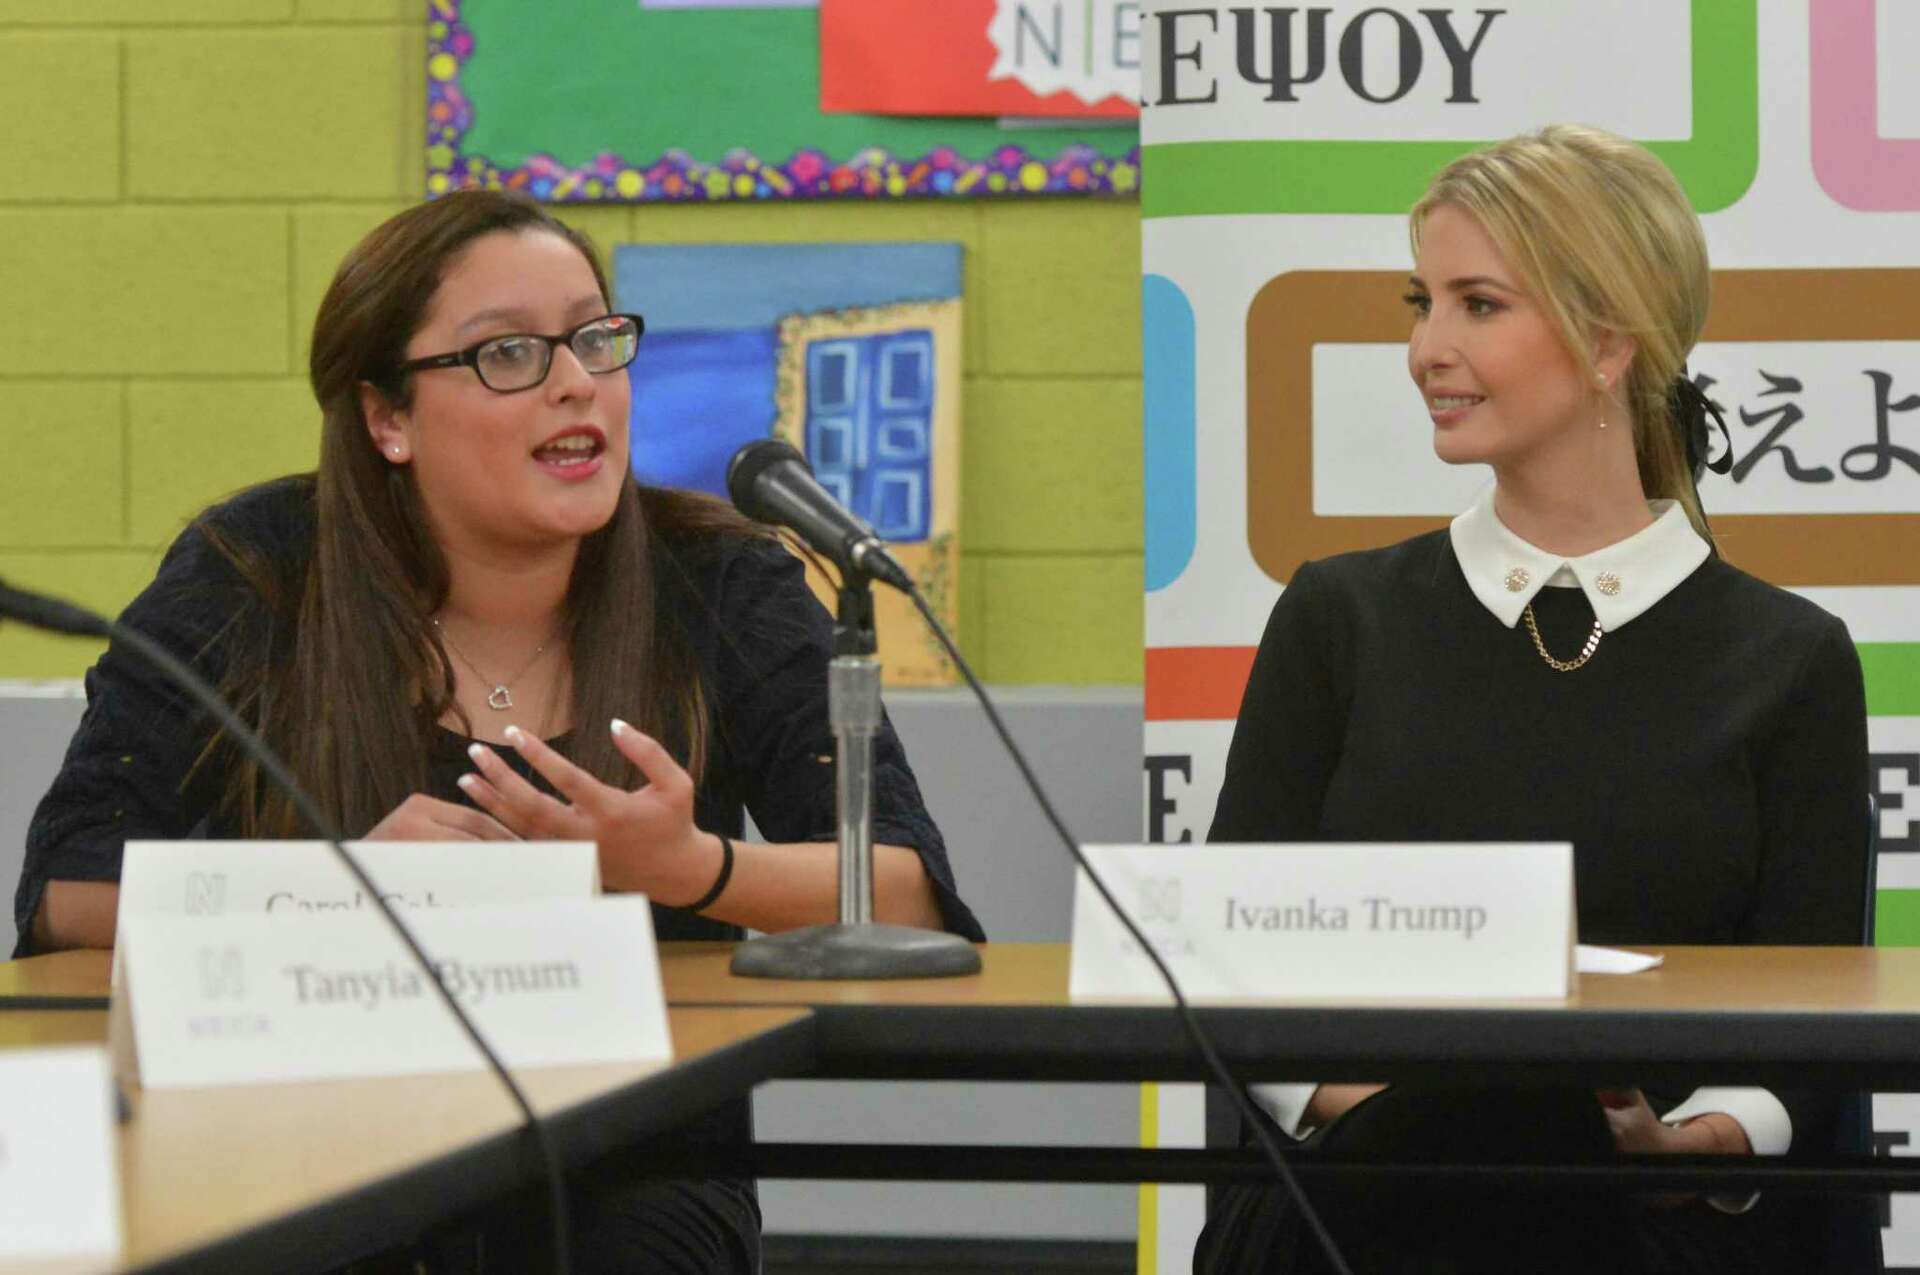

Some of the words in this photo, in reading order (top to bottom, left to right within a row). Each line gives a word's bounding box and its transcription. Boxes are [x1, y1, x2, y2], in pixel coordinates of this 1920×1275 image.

[1141, 7, 1506, 108] ΕΨΟΥ
[1692, 368, 1920, 485] えよ
[1223, 897, 1350, 932] Ivanka
[1361, 898, 1488, 940] Trump
[284, 961, 422, 1010] Tanyia
[434, 957, 580, 1003] Bynum
